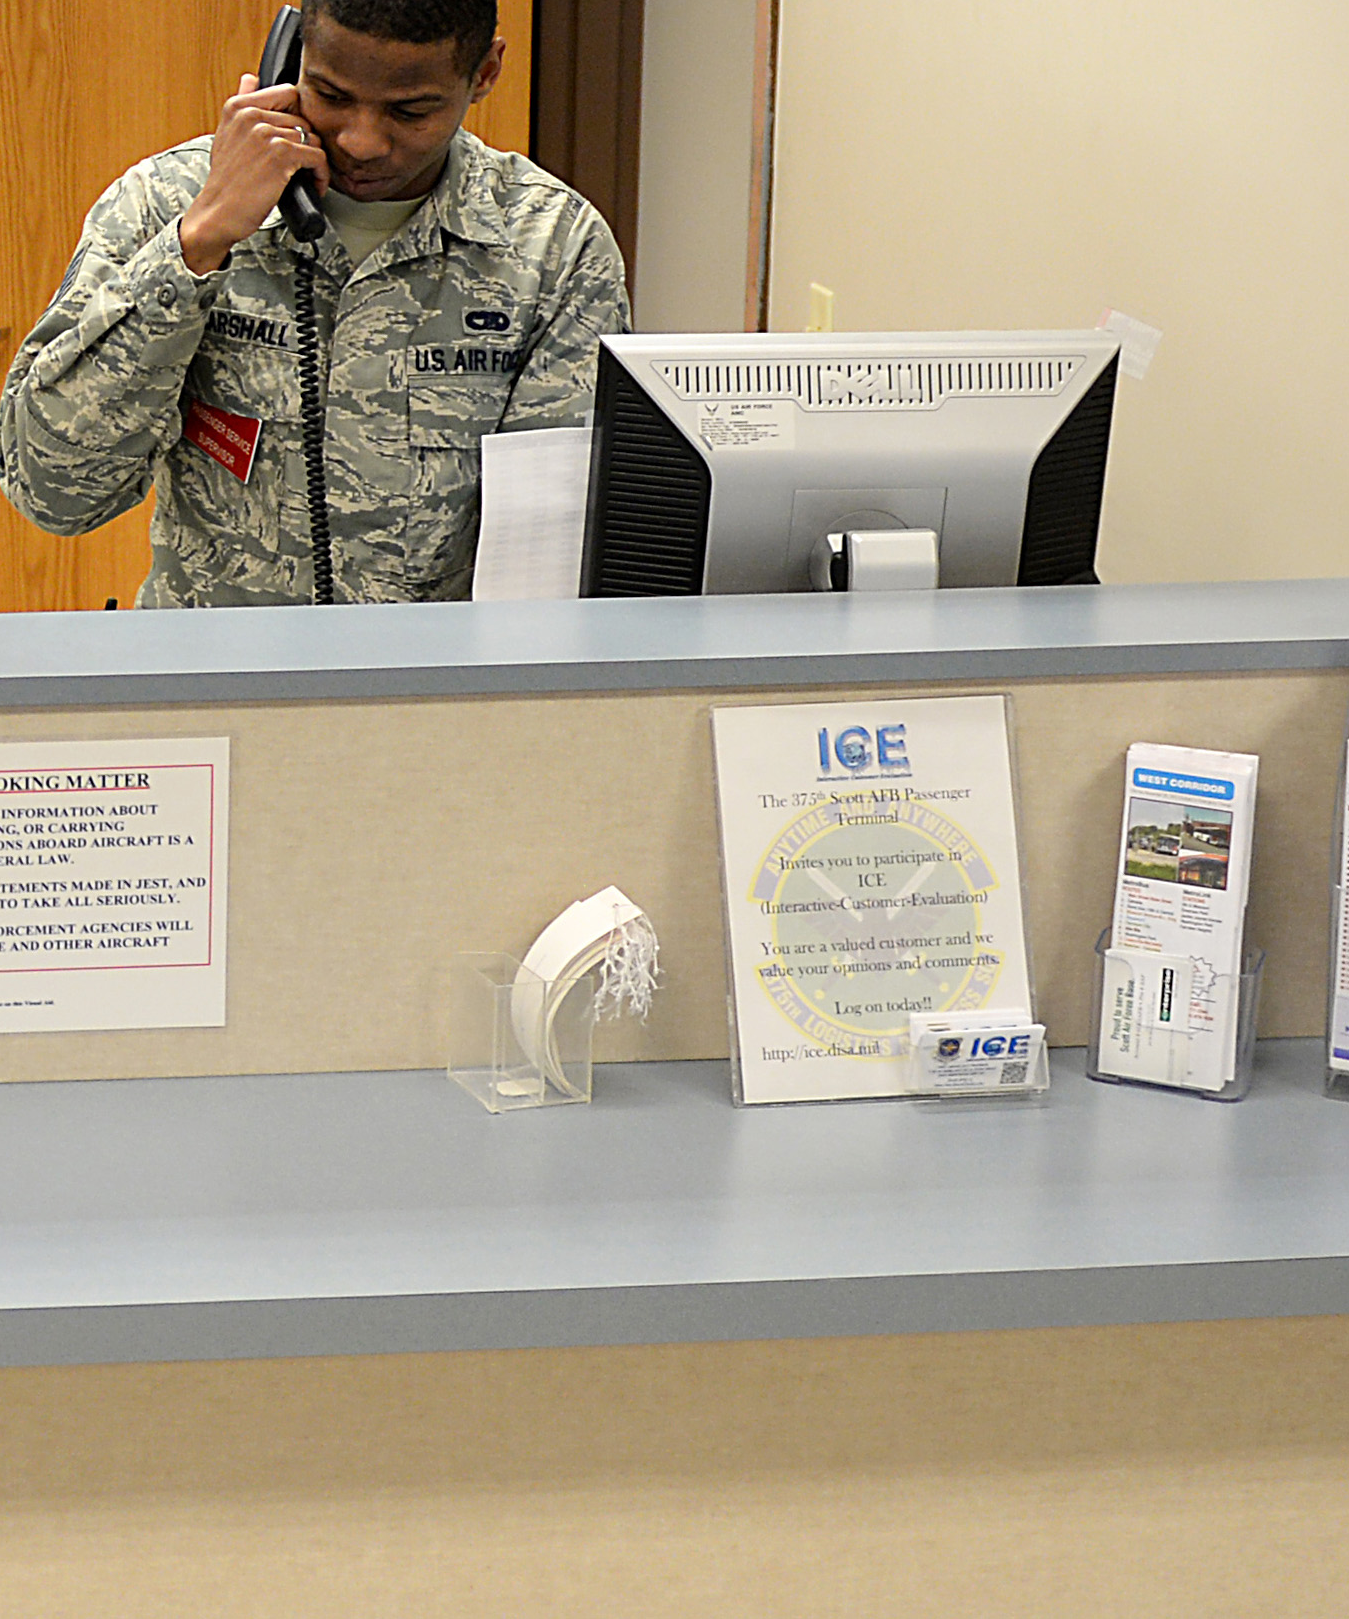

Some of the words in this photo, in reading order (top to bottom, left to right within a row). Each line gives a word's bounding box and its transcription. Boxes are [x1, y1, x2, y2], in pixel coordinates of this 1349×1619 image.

[204, 311, 289, 347] ARSHALL
[415, 349, 447, 372] U.S.
[454, 349, 487, 372] AIR
[819, 368, 923, 402] DELL
[226, 428, 252, 456] SERVICE
[818, 724, 910, 771] ICE
[66, 773, 148, 790] MATTER
[1138, 773, 1168, 786] WEST
[1169, 778, 1227, 795] CORRIDOR
[758, 793, 787, 808] The
[827, 789, 864, 808] Scott
[866, 788, 901, 806] AFB
[904, 784, 970, 802] Passenger
[1, 806, 104, 818] INFORMATION
[109, 804, 155, 815] ABOUT
[834, 809, 898, 826] Terminal
[23, 823, 43, 834] OR
[47, 821, 124, 833] CARRYING
[27, 838, 86, 849] ABOARD
[91, 835, 161, 847] AIRCRAFT
[168, 835, 180, 845] IS
[185, 835, 193, 844] A
[38, 854, 73, 864] LAW.
[779, 854, 824, 873] Invites
[827, 857, 852, 870] you
[856, 855, 870, 865] to
[874, 847, 946, 868] participate
[946, 846, 961, 864] in
[71, 880, 112, 890] MADE
[117, 879, 131, 889] IN
[135, 878, 172, 889] JEST,
[176, 877, 205, 887] AND
[858, 873, 885, 887] ICE
[0, 898, 17, 909] TO
[23, 897, 60, 908] TAKE
[65, 896, 92, 906] ALL
[96, 893, 179, 905] SERIOUSLY.
[760, 890, 987, 913] (Interactive-Customer-Evaluation)
[80, 922, 151, 933] AGENCIES
[156, 920, 192, 931] WILL
[10, 941, 39, 951] AND
[43, 939, 92, 950] OTHER
[97, 936, 167, 948] AIRCRAFT
[761, 940, 790, 955] You
[793, 944, 815, 954] are
[819, 943, 827, 952] a
[830, 936, 875, 952] valued
[878, 936, 941, 949] customer
[945, 930, 973, 945] and
[973, 934, 993, 944] we
[758, 964, 796, 978] value
[796, 964, 830, 978] your
[832, 957, 891, 977] opinions
[893, 954, 922, 973] and
[922, 953, 999, 972] comments.
[835, 999, 862, 1017] Log
[864, 1003, 882, 1013] on
[886, 995, 931, 1014] today!!
[1115, 987, 1124, 1008] serve
[1112, 1009, 1122, 1017] to
[1123, 1000, 1134, 1020] Force
[1110, 1018, 1122, 1041] Proud
[1121, 1022, 1132, 1032] Air
[970, 1034, 1031, 1057] ICE
[1120, 1034, 1131, 1053] Scott
